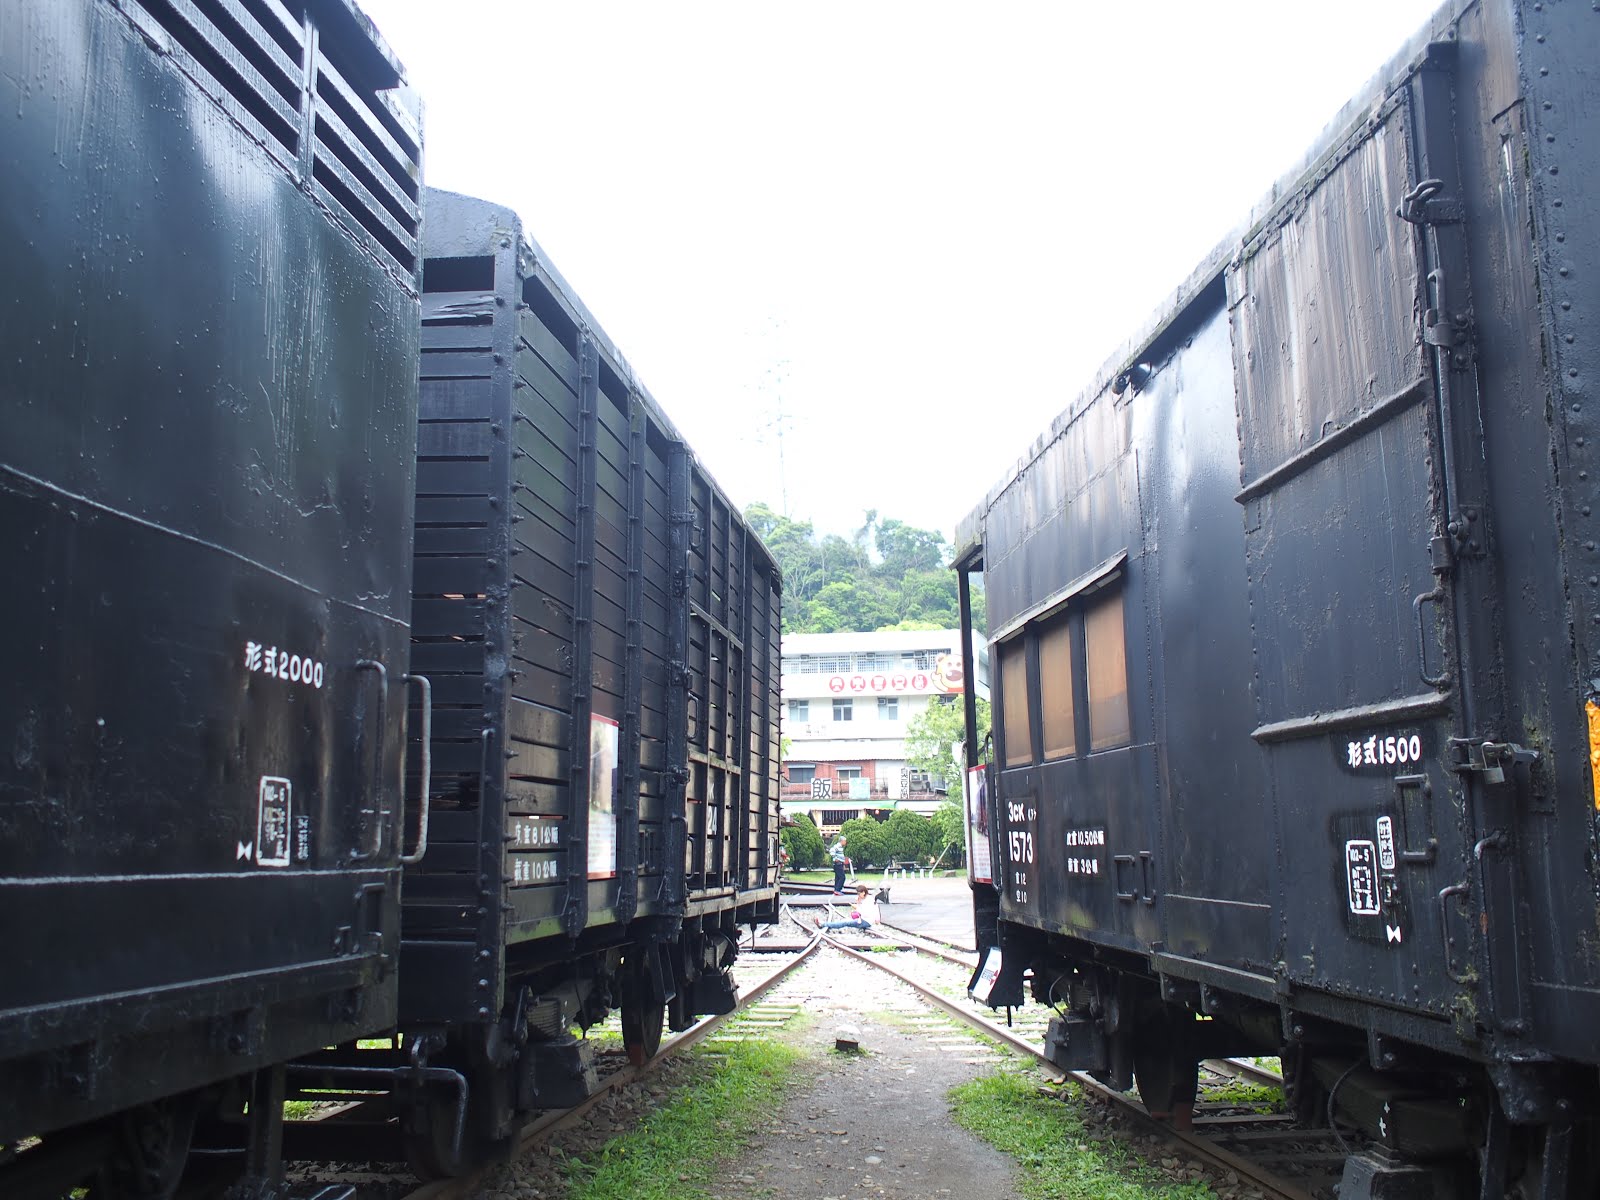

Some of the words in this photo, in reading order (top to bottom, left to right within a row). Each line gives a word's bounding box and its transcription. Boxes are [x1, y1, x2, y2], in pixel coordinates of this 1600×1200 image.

[245, 641, 323, 688] 形式2000
[1347, 735, 1421, 768] 形式1500
[812, 778, 832, 799] 飯
[1008, 800, 1025, 822] 3CK
[1008, 831, 1033, 864] 1573
